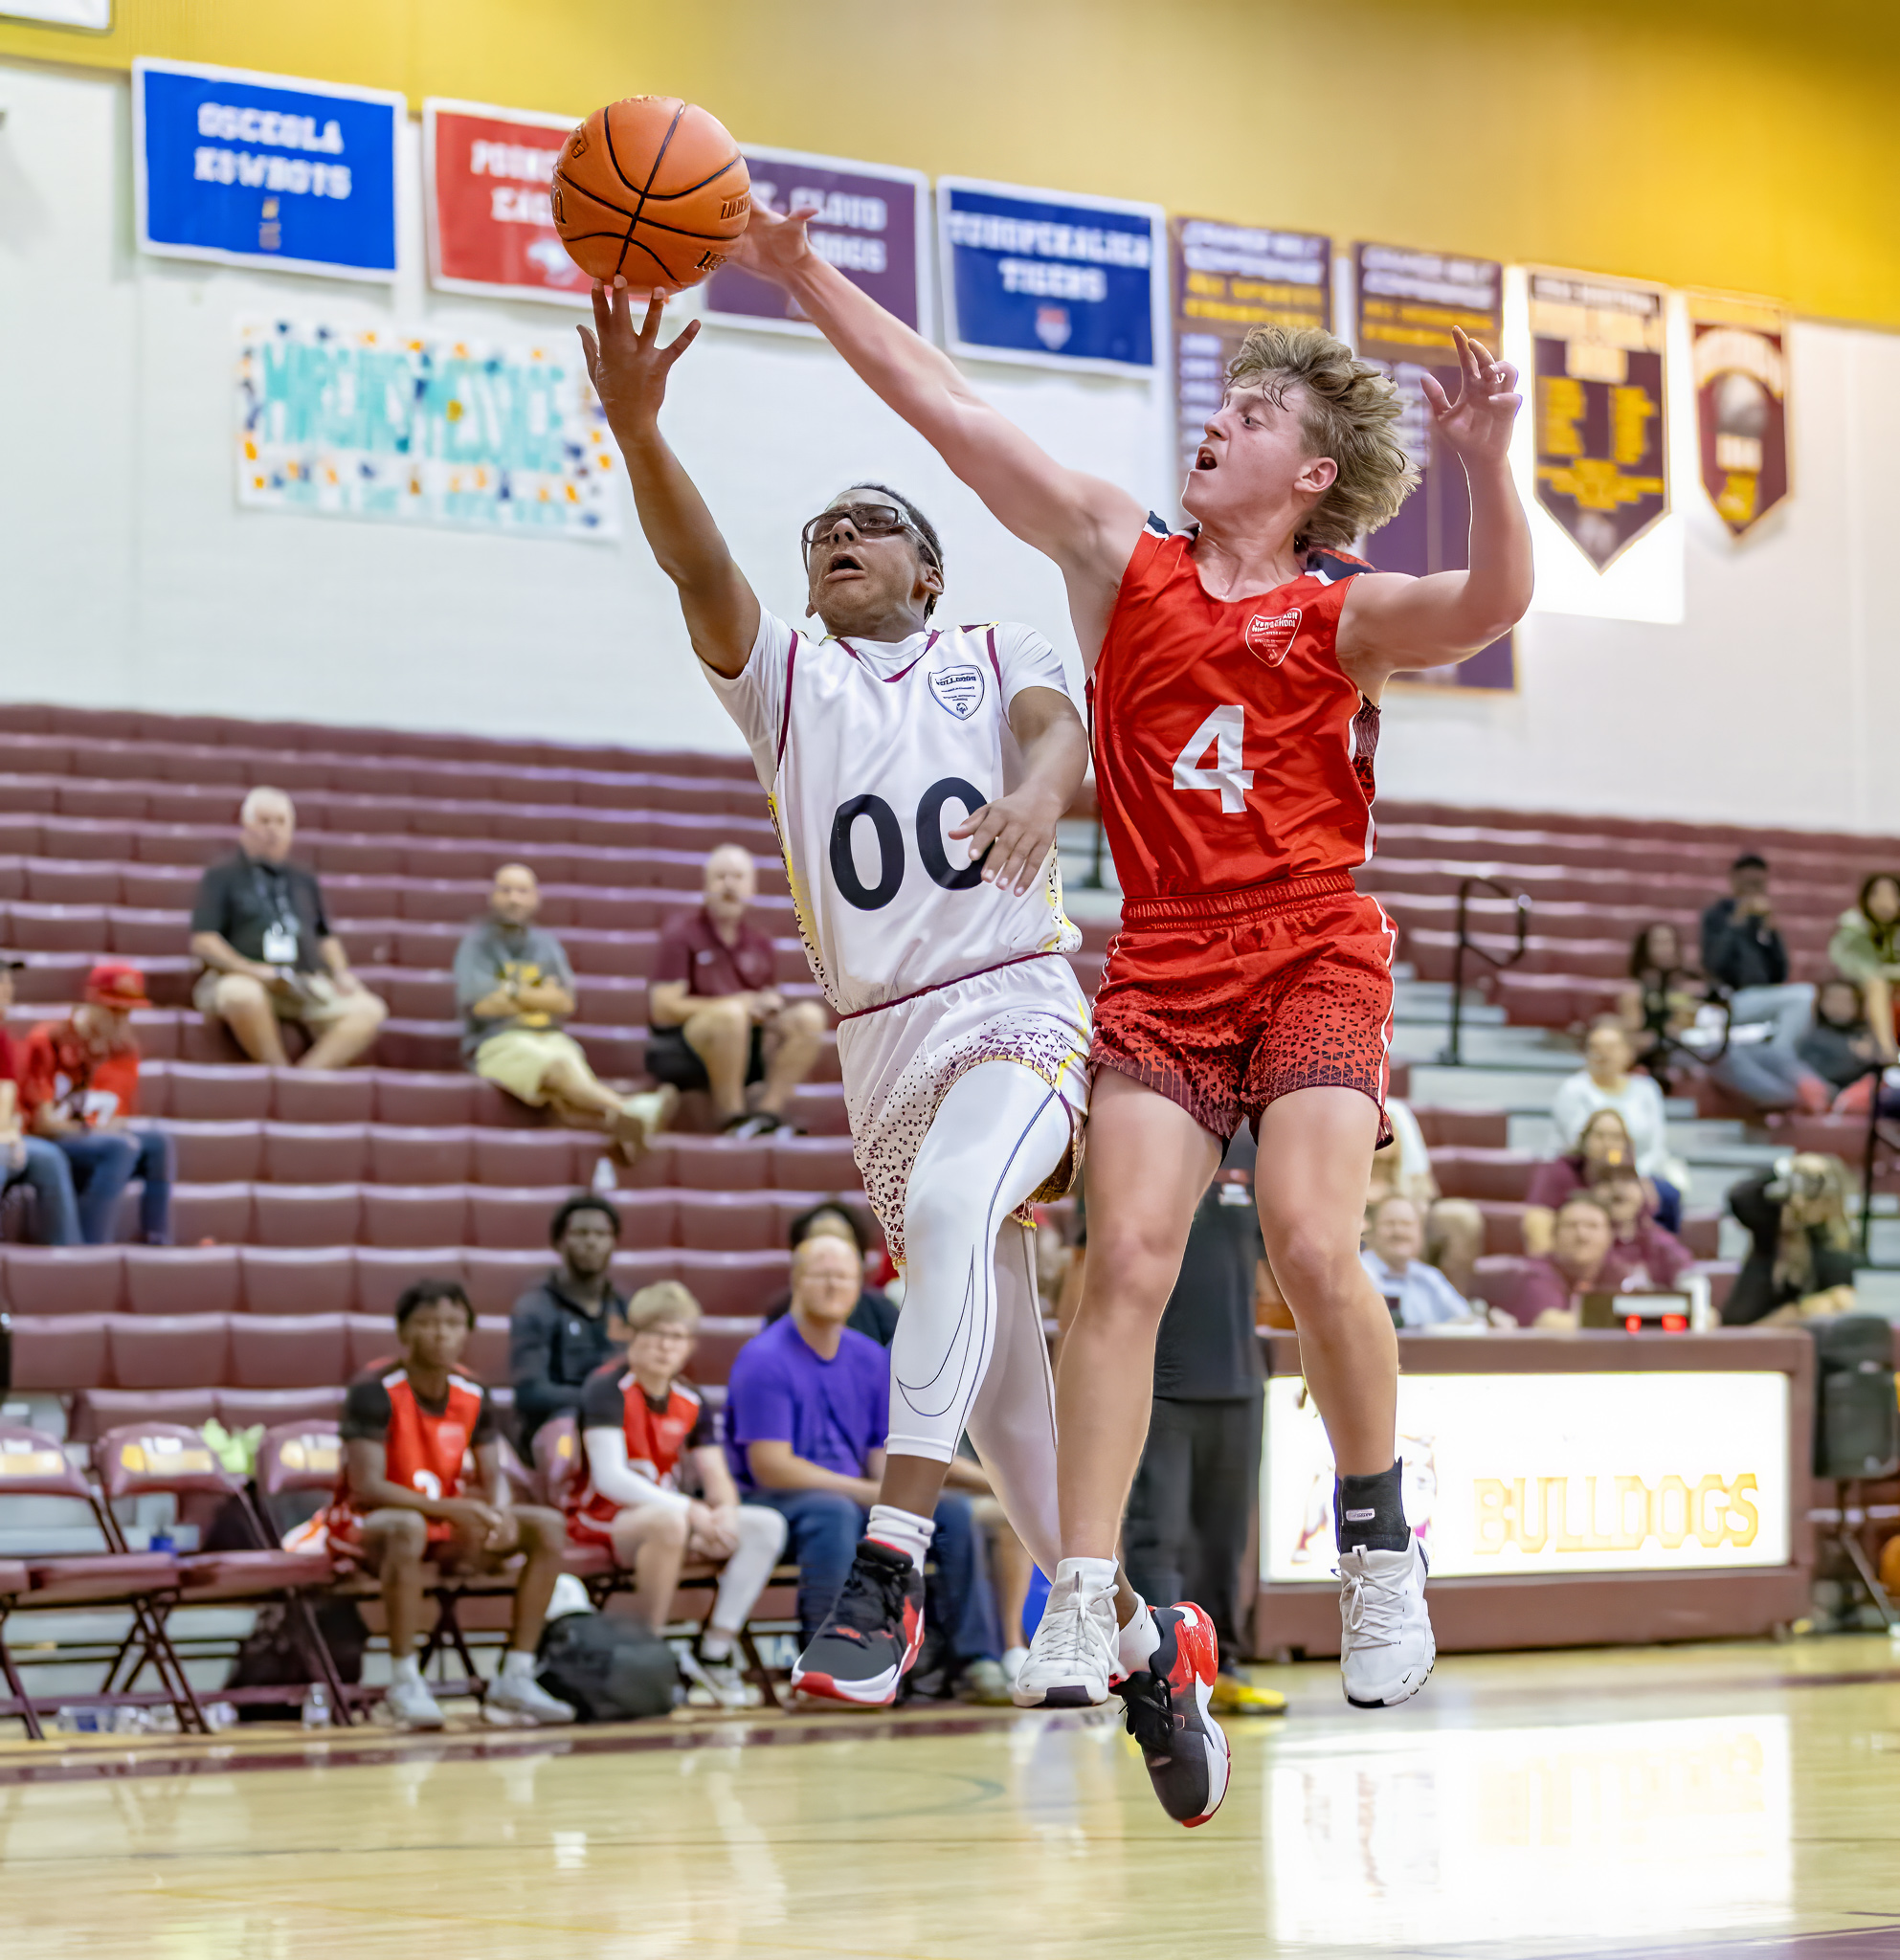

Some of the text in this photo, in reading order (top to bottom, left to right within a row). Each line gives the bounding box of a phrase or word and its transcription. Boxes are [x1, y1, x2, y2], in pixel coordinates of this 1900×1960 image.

[1173, 704, 1254, 813] 4
[829, 776, 995, 911] 00
[1472, 1473, 1759, 1555] BULLDOGS
